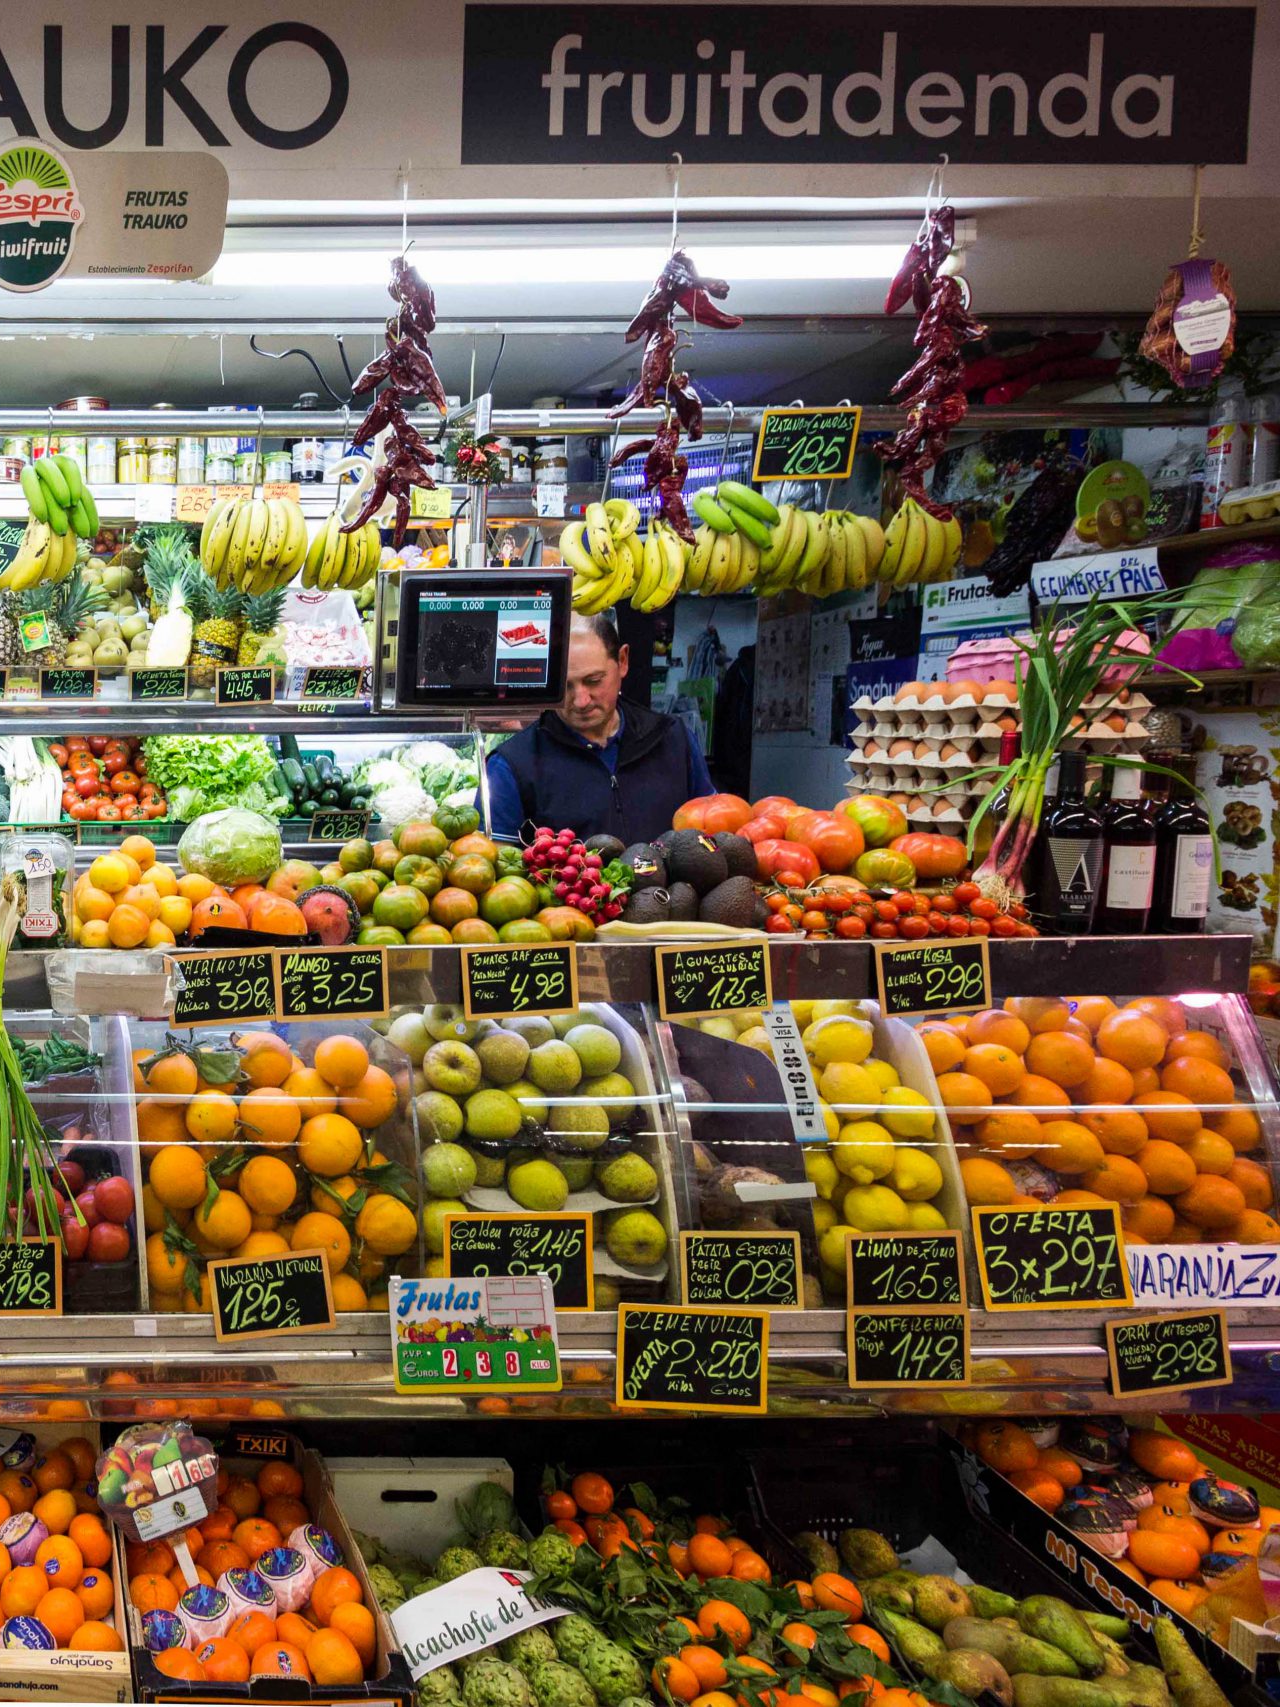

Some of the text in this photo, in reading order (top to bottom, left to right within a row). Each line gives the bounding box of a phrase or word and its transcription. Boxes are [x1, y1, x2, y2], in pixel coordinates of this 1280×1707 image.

[542, 32, 1175, 137] fruitadenda
[125, 190, 189, 207] FRUTAS
[123, 213, 188, 230] TRAUKO
[88, 263, 193, 274] Establecimiento Zesprifan
[1121, 557, 1140, 567] DEL
[1120, 564, 1168, 595] PAÍS
[297, 703, 326, 713] FELIPE
[25, 918, 53, 927] TXIKI
[471, 953, 508, 966] TOMATES
[511, 951, 531, 963] RAF
[675, 951, 762, 969] AGUACATES DE
[890, 948, 952, 961] TOMATE ROSA
[284, 954, 330, 974] MANGO
[451, 1220, 502, 1239] Golden
[989, 1212, 1095, 1235] OFERTA
[19, 1245, 45, 1260] Pera
[687, 1236, 793, 1258] PATATA ESPECIAL
[855, 1238, 955, 1259] LIMÓN DE ZUMO
[13, 1261, 34, 1272] KILO
[220, 1258, 322, 1288] NARANJA NATURAL
[691, 1259, 722, 1271] FREIR
[984, 1245, 1019, 1298] 3
[1129, 1245, 1237, 1300] NARANJA
[690, 1271, 720, 1284] COCER
[396, 1281, 481, 1317] Frutas
[689, 1287, 723, 1299] GUISAR
[624, 1311, 755, 1338] CLEMENVILLA
[854, 1314, 964, 1334] CONFERENCIA
[1116, 1321, 1150, 1343] ORRI
[1119, 1343, 1157, 1356] VARIEDAD
[531, 1360, 550, 1369] KILO
[624, 1338, 670, 1399] OFERTA
[663, 1338, 695, 1378] 2
[240, 1438, 287, 1453] TXIKI
[1045, 1529, 1155, 1635] Mi Tesor
[401, 1609, 498, 1670] lcachofa
[497, 1596, 524, 1625] de
[50, 1658, 114, 1671] Sanahuja
